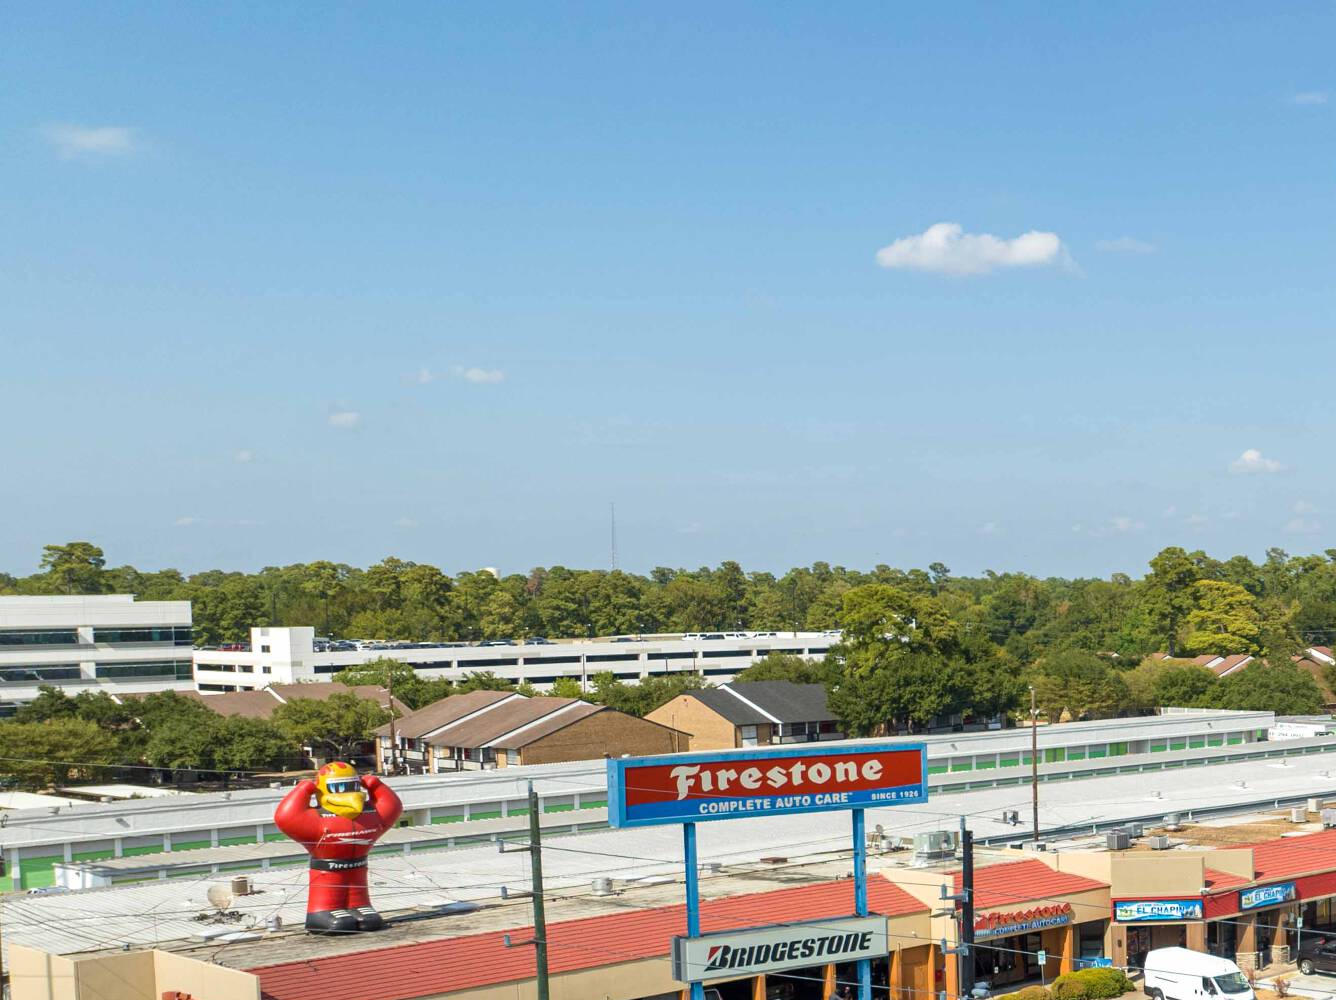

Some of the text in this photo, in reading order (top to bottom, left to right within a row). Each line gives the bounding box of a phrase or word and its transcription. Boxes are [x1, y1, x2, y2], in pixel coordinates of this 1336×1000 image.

[670, 759, 883, 801] Firestone
[699, 798, 771, 814] COMPLETE
[776, 795, 811, 809] AUTO
[871, 789, 919, 801] SINCE 1926
[1136, 906, 1149, 915] EL
[704, 931, 874, 972] BRIDGESTONE
